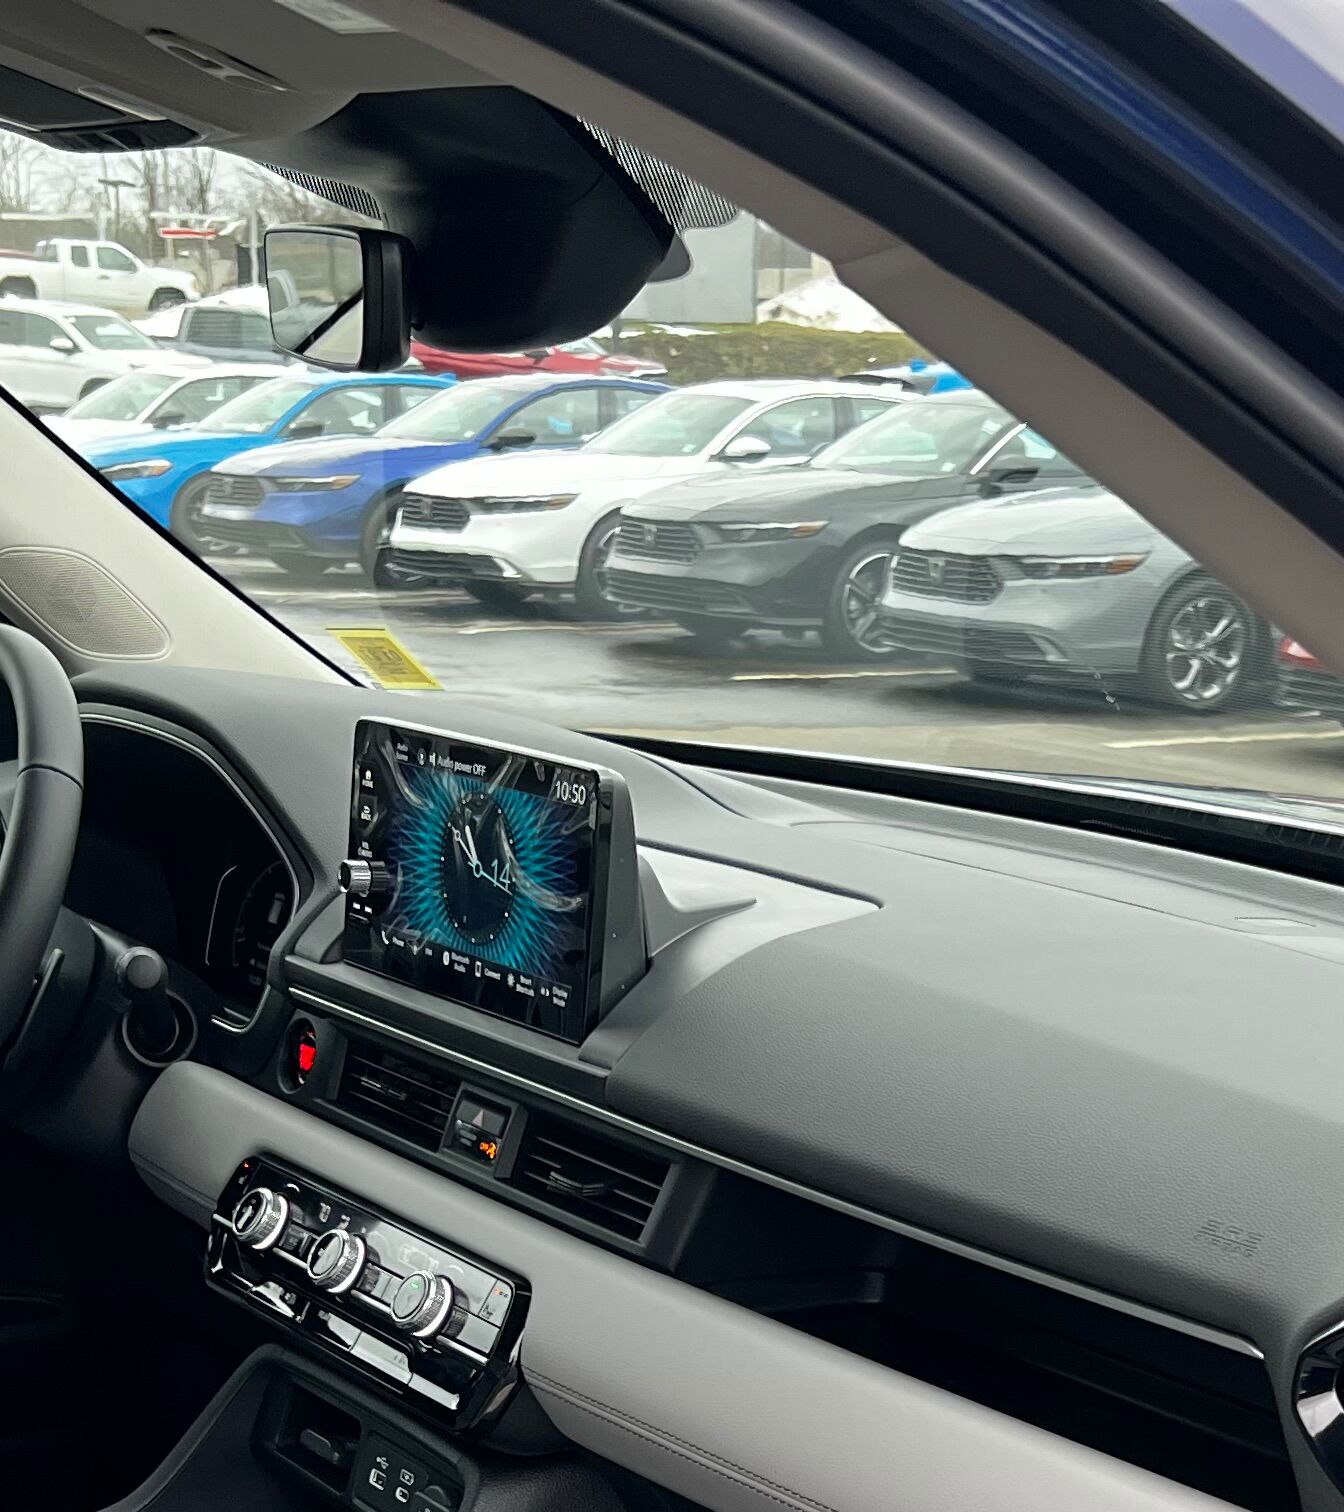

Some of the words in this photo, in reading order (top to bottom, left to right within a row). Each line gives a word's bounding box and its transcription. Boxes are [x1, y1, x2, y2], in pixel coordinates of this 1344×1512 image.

[472, 763, 487, 777] OFF
[555, 779, 587, 806] 10:50
[490, 857, 511, 887] 14
